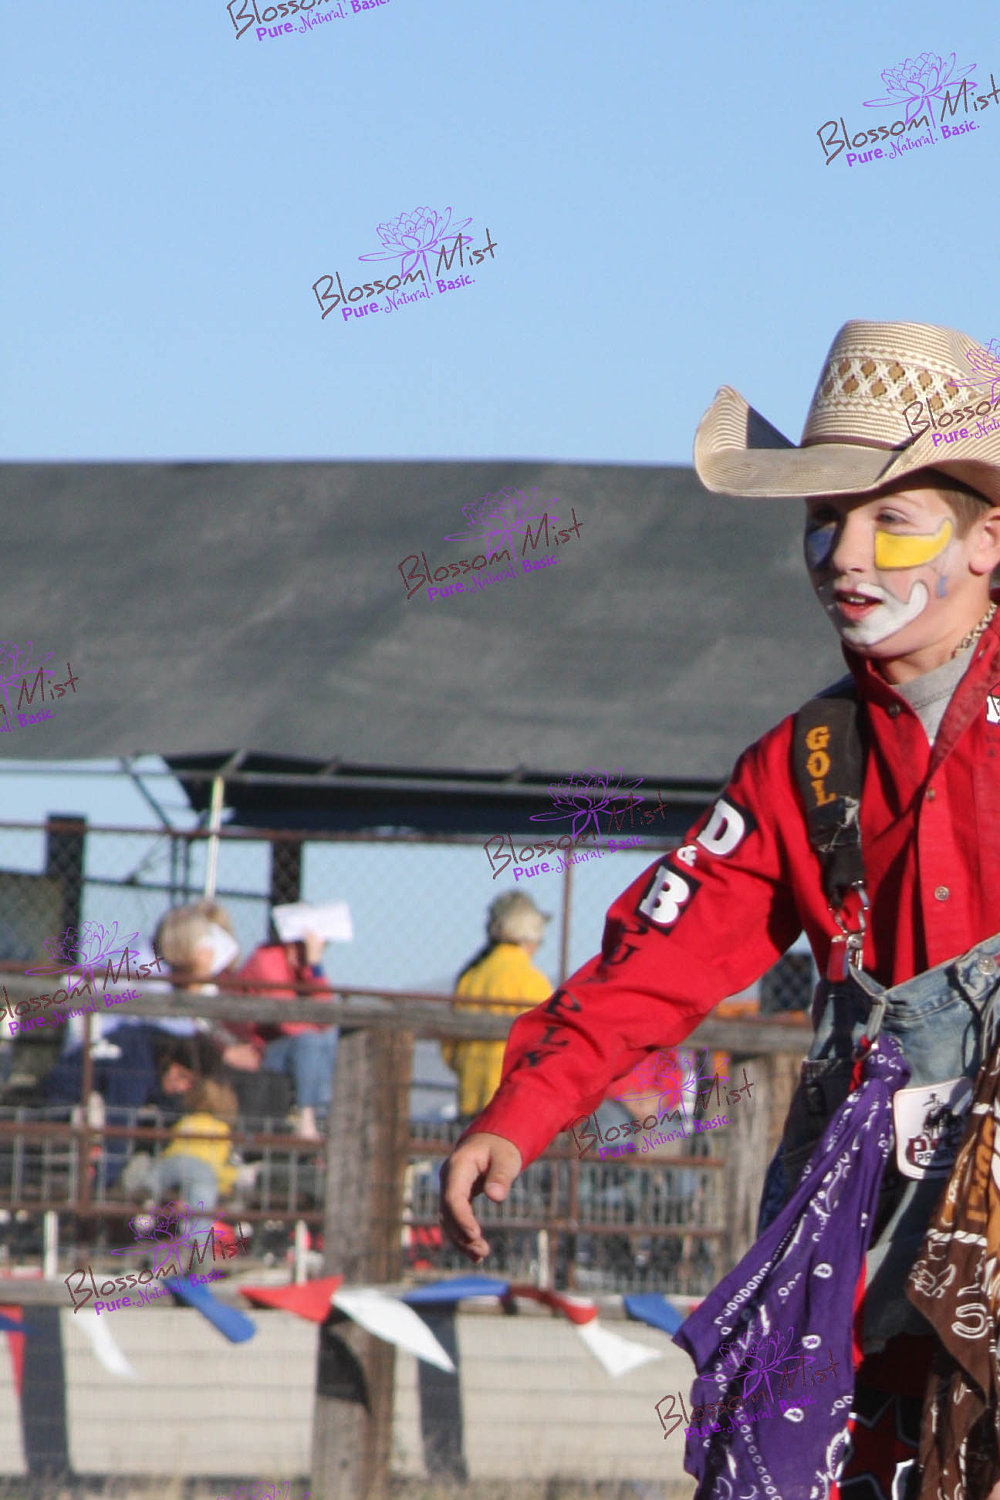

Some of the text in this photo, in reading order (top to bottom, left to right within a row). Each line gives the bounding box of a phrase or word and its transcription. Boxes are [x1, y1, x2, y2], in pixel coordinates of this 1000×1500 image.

[639, 799, 745, 924] D & B
